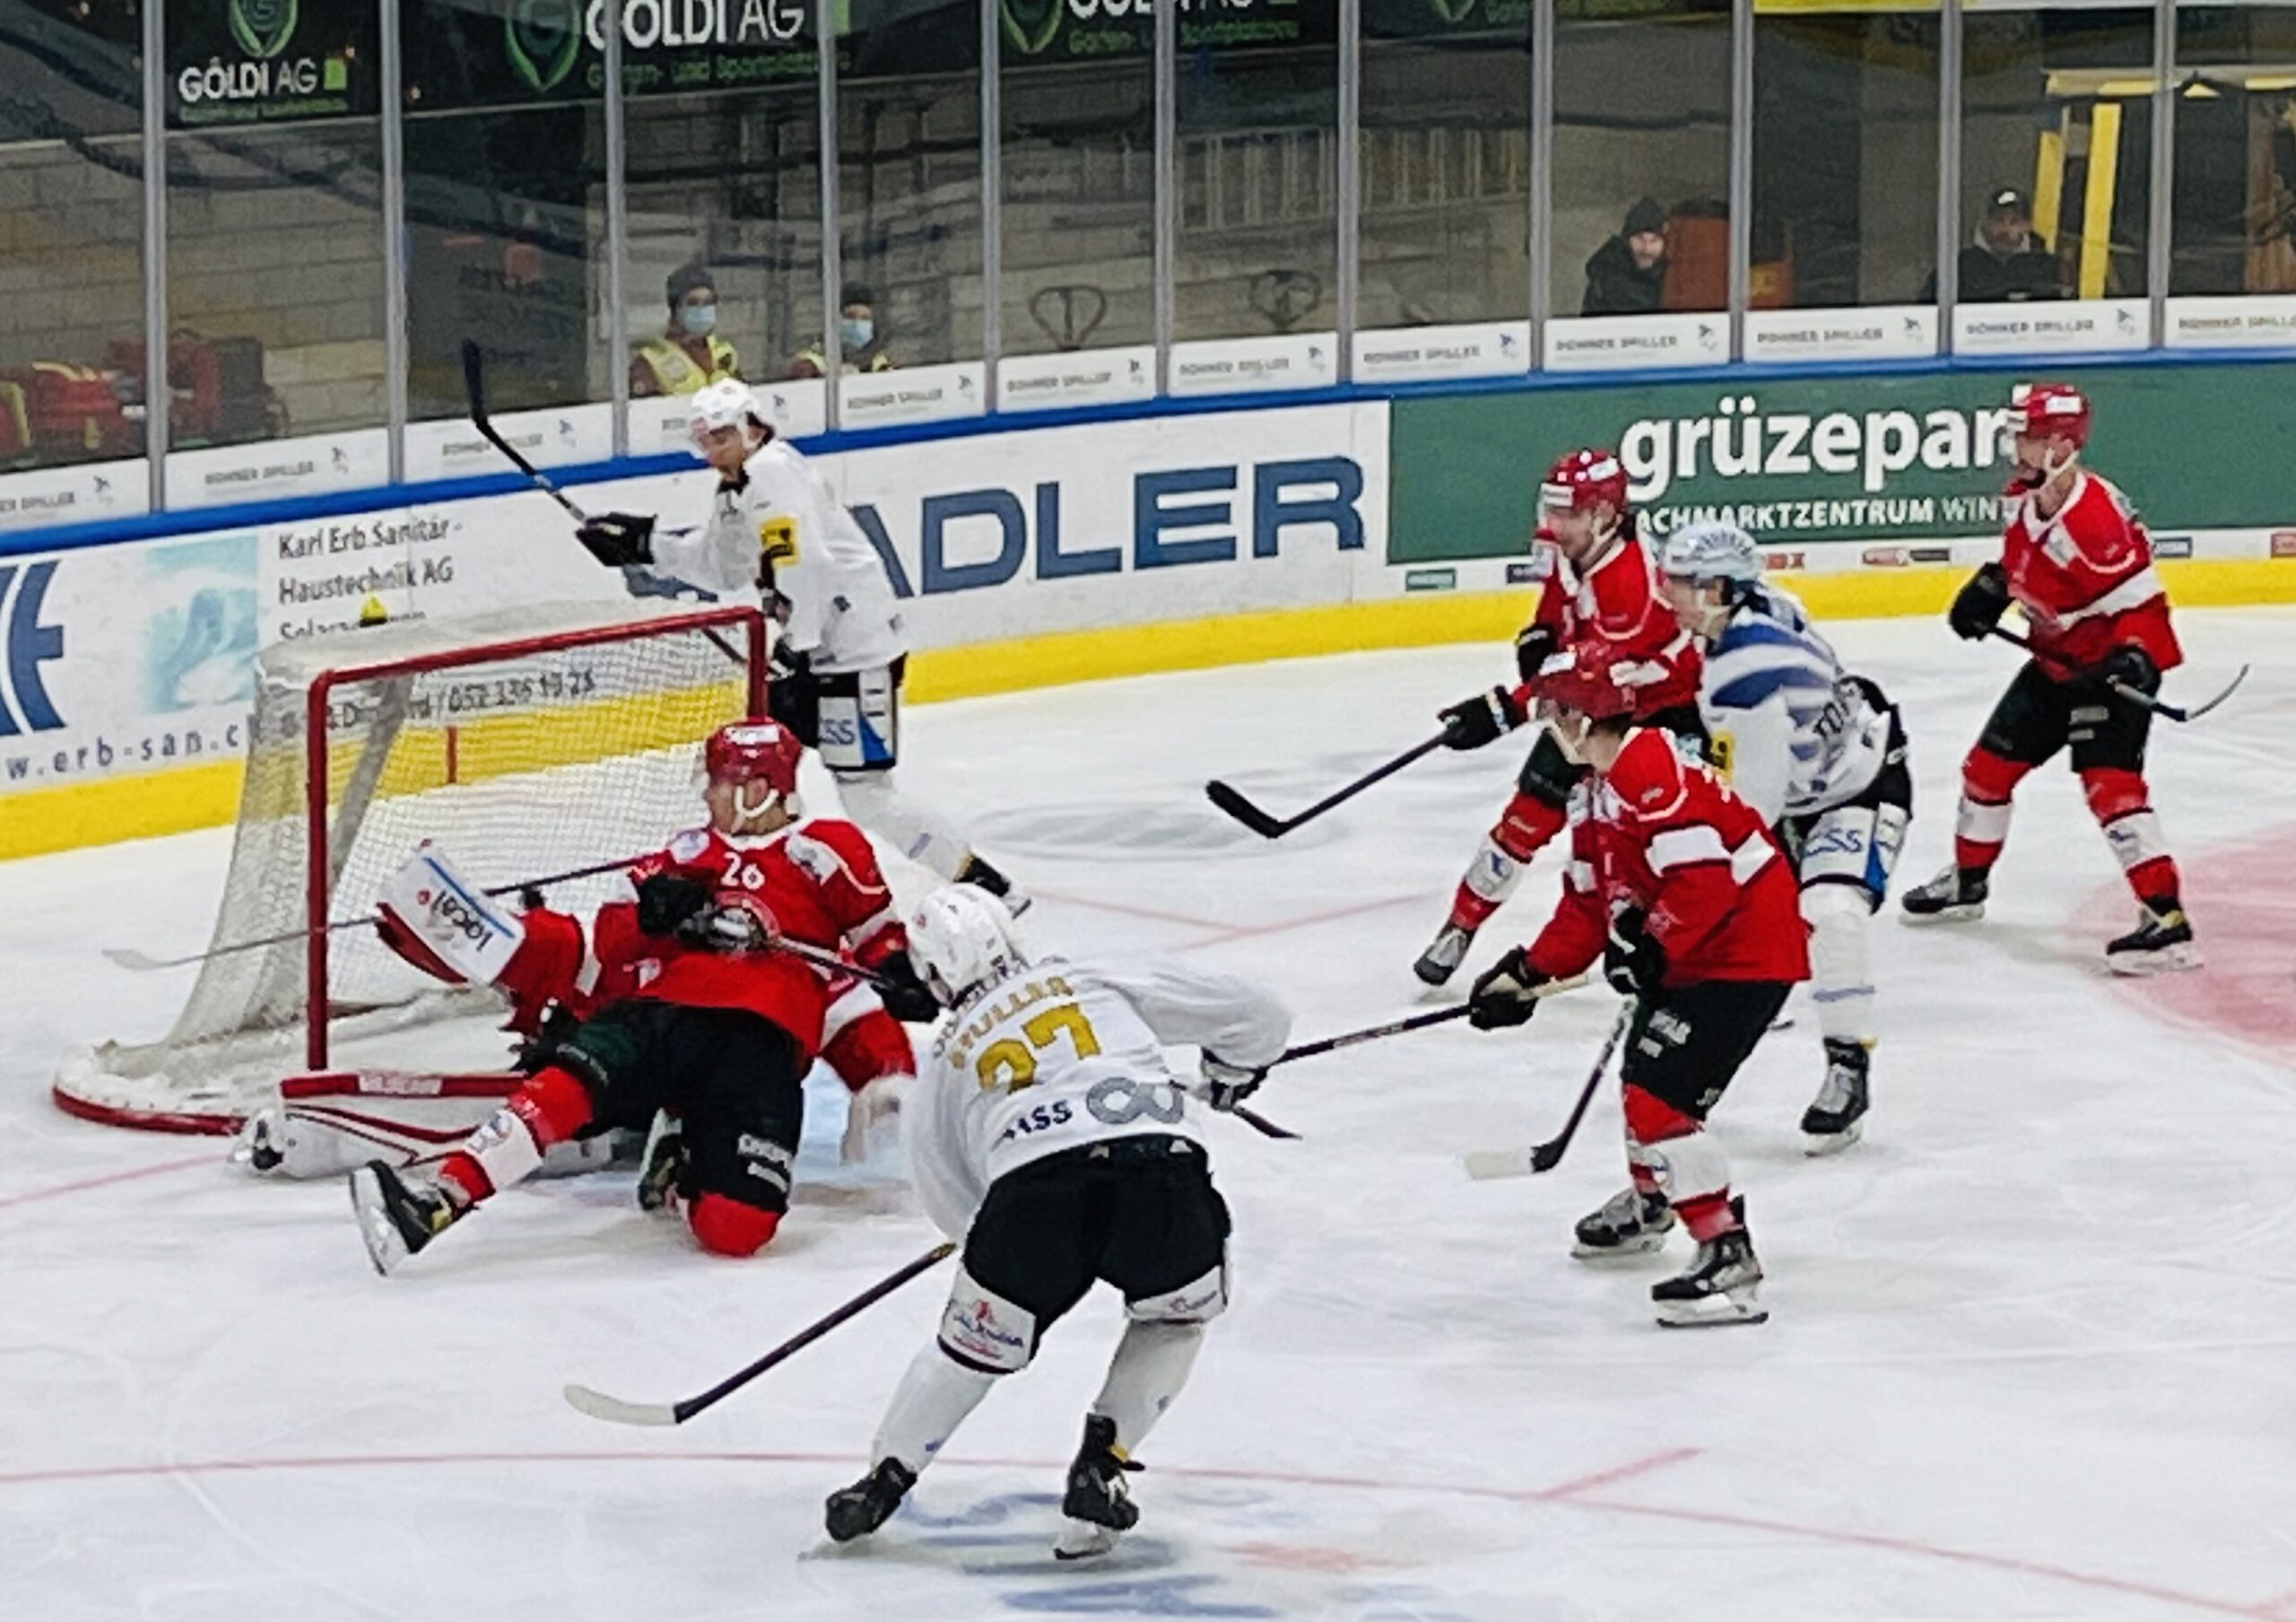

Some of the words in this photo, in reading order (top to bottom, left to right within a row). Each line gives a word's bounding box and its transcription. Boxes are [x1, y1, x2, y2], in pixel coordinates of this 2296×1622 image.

[274, 58, 317, 93] AG
[1636, 499, 1935, 535] ACHMARKTZENTRUM
[279, 529, 324, 559] Karl
[328, 524, 366, 554] Erb
[279, 561, 417, 605] Haustechnik
[422, 555, 454, 586] AG
[720, 850, 766, 891] 26
